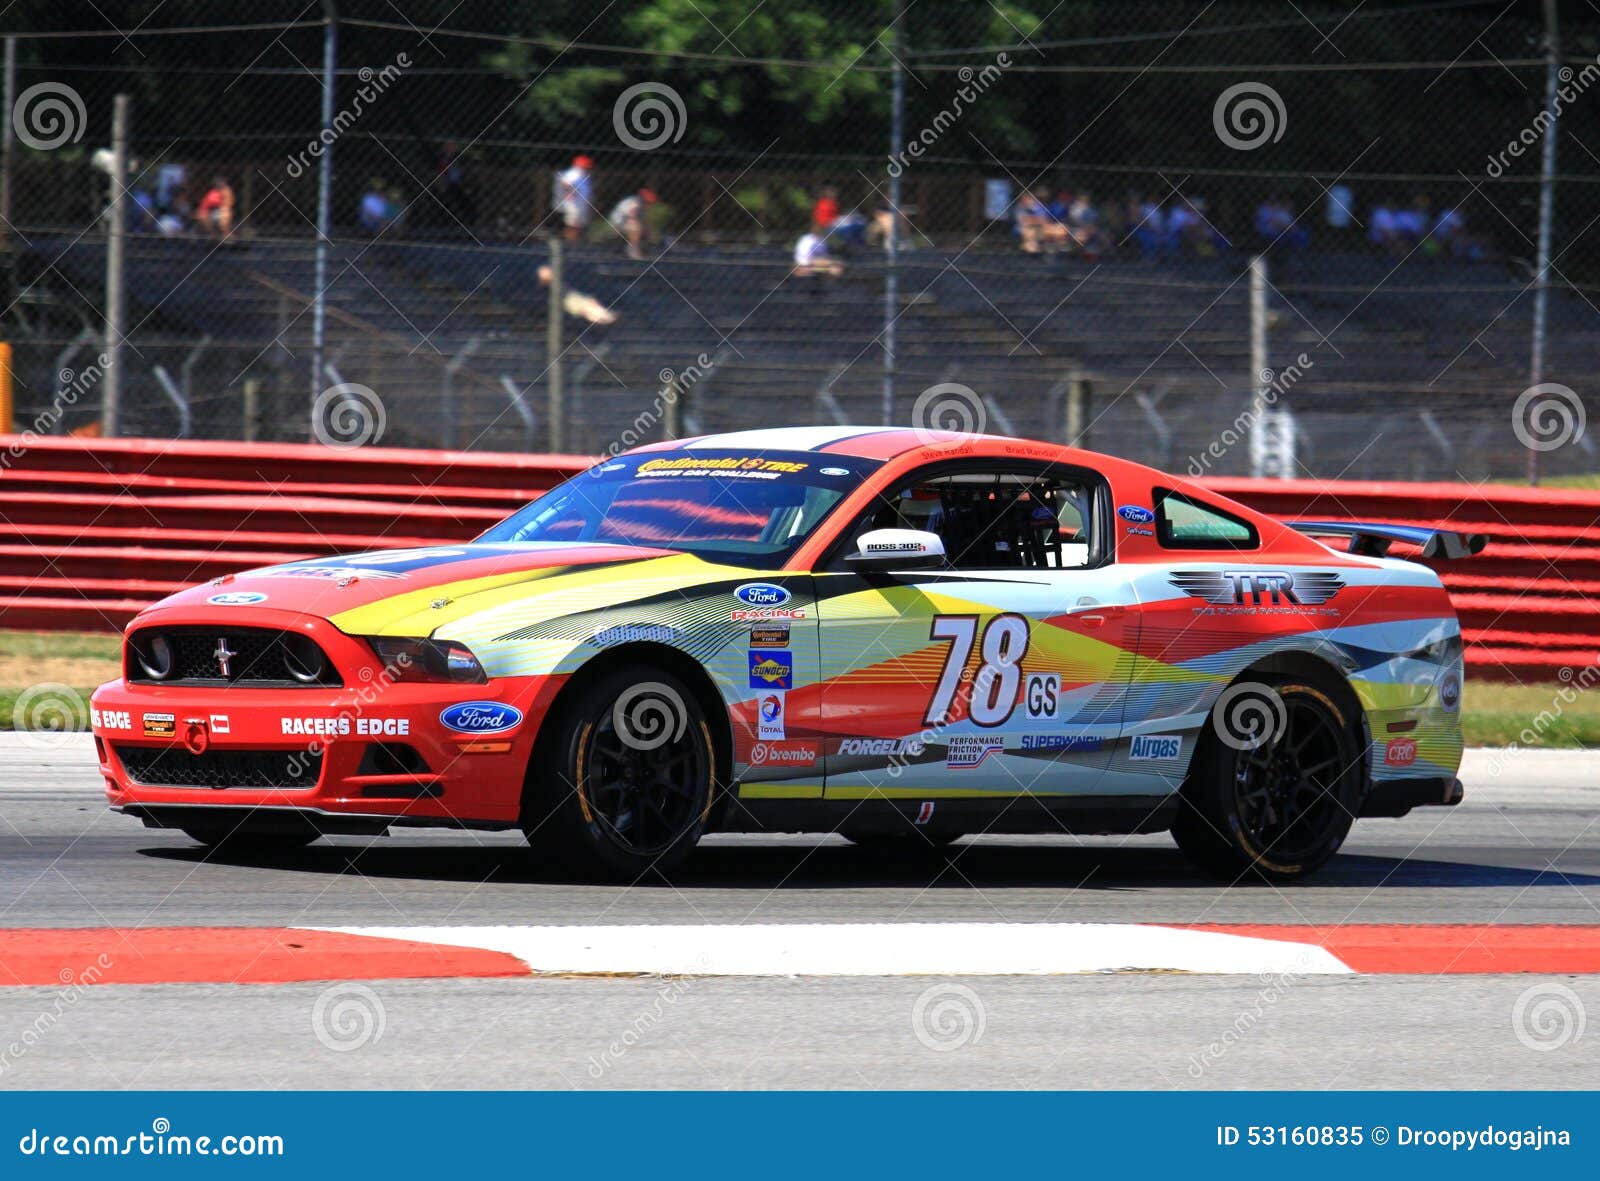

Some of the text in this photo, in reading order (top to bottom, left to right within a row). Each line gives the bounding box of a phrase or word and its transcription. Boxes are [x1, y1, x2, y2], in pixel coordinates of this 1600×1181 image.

[637, 458, 748, 473] Continental
[758, 461, 809, 473] TIRE
[1223, 570, 1300, 605] TFR
[731, 608, 806, 621] RACING
[752, 664, 790, 677] SUNOCO
[921, 612, 1030, 728] 78
[1027, 676, 1058, 717] GS
[102, 710, 132, 729] EDGE
[281, 718, 410, 736] RACERS EDGE
[949, 737, 1005, 745] PERFORMANCE
[1131, 736, 1179, 759] Airgas
[769, 746, 816, 761] brembo
[948, 745, 983, 753] FRICTION
[1388, 745, 1415, 761] CRC
[947, 754, 978, 762] BRAKES
